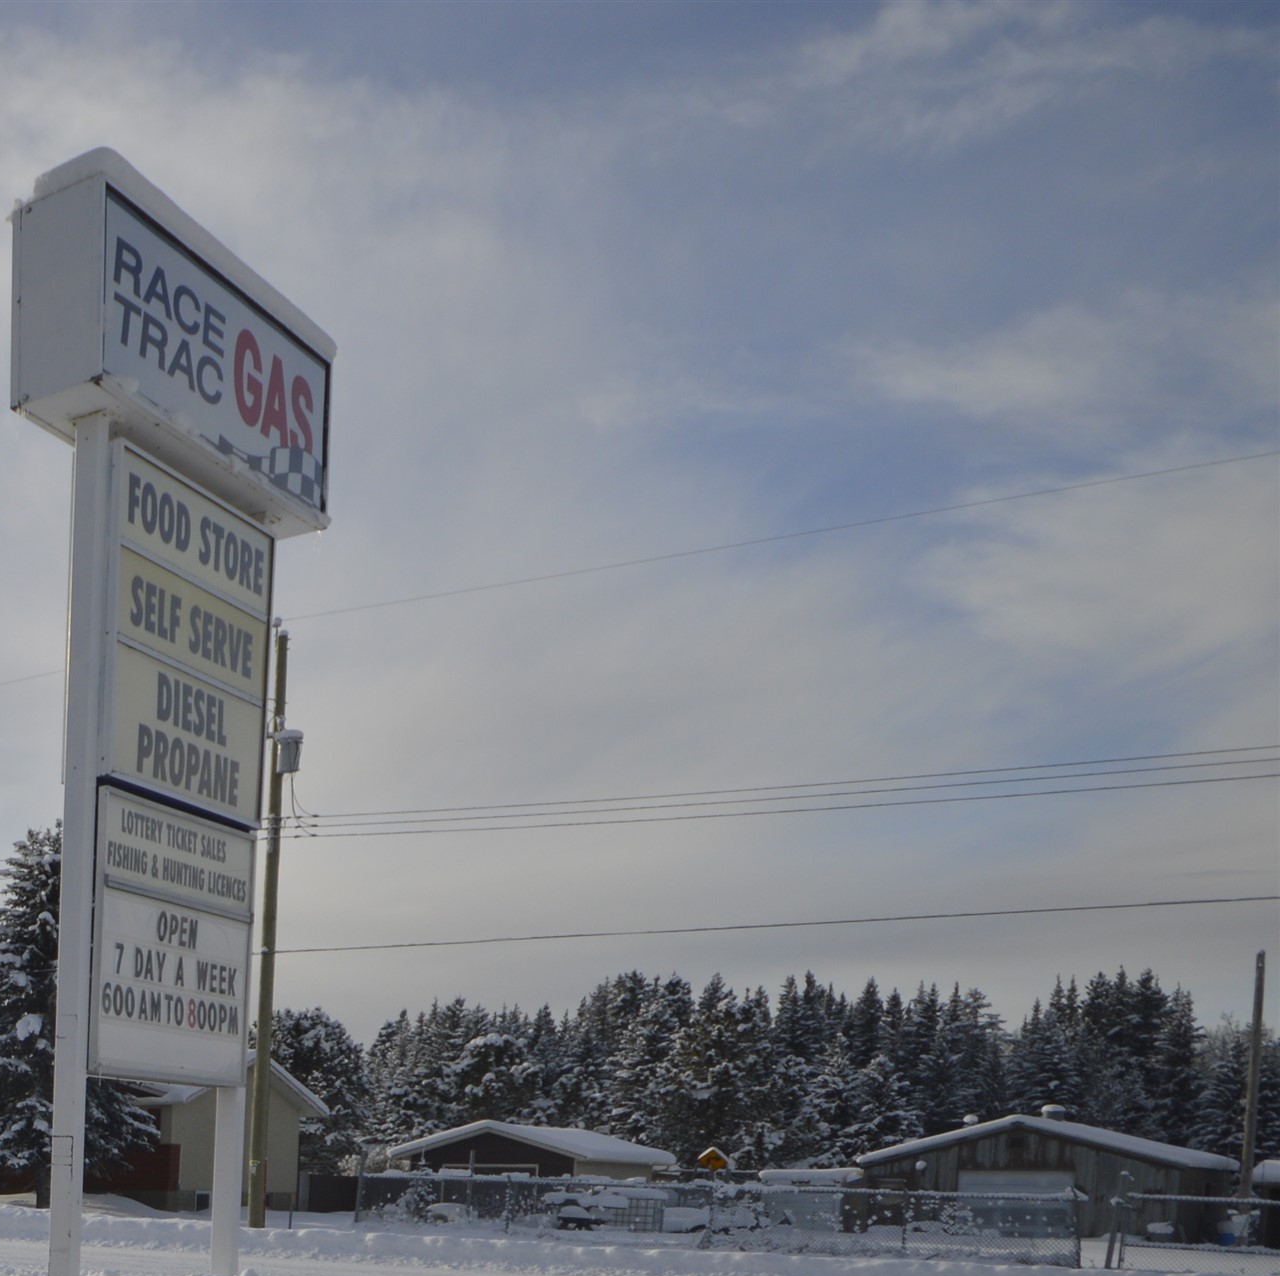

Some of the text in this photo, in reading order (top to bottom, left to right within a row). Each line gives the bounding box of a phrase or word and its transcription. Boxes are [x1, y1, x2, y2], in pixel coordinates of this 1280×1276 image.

[113, 236, 226, 359] RACE
[114, 291, 224, 405] TRAC
[234, 328, 314, 453] GAS
[127, 472, 264, 597] FOOD STORE
[130, 575, 253, 680] SELF SERVE
[157, 671, 227, 748] DIESEL
[136, 722, 240, 807] PROPANE
[107, 840, 247, 903] FISHING & HUNTING LICENCES
[121, 808, 226, 863] LOTTERY TICKET SALES
[115, 942, 237, 997] 7 DAY A WEEK
[157, 910, 198, 950] OPEN
[102, 982, 135, 1018] 600
[138, 989, 161, 1023] AM
[164, 993, 184, 1026] TO
